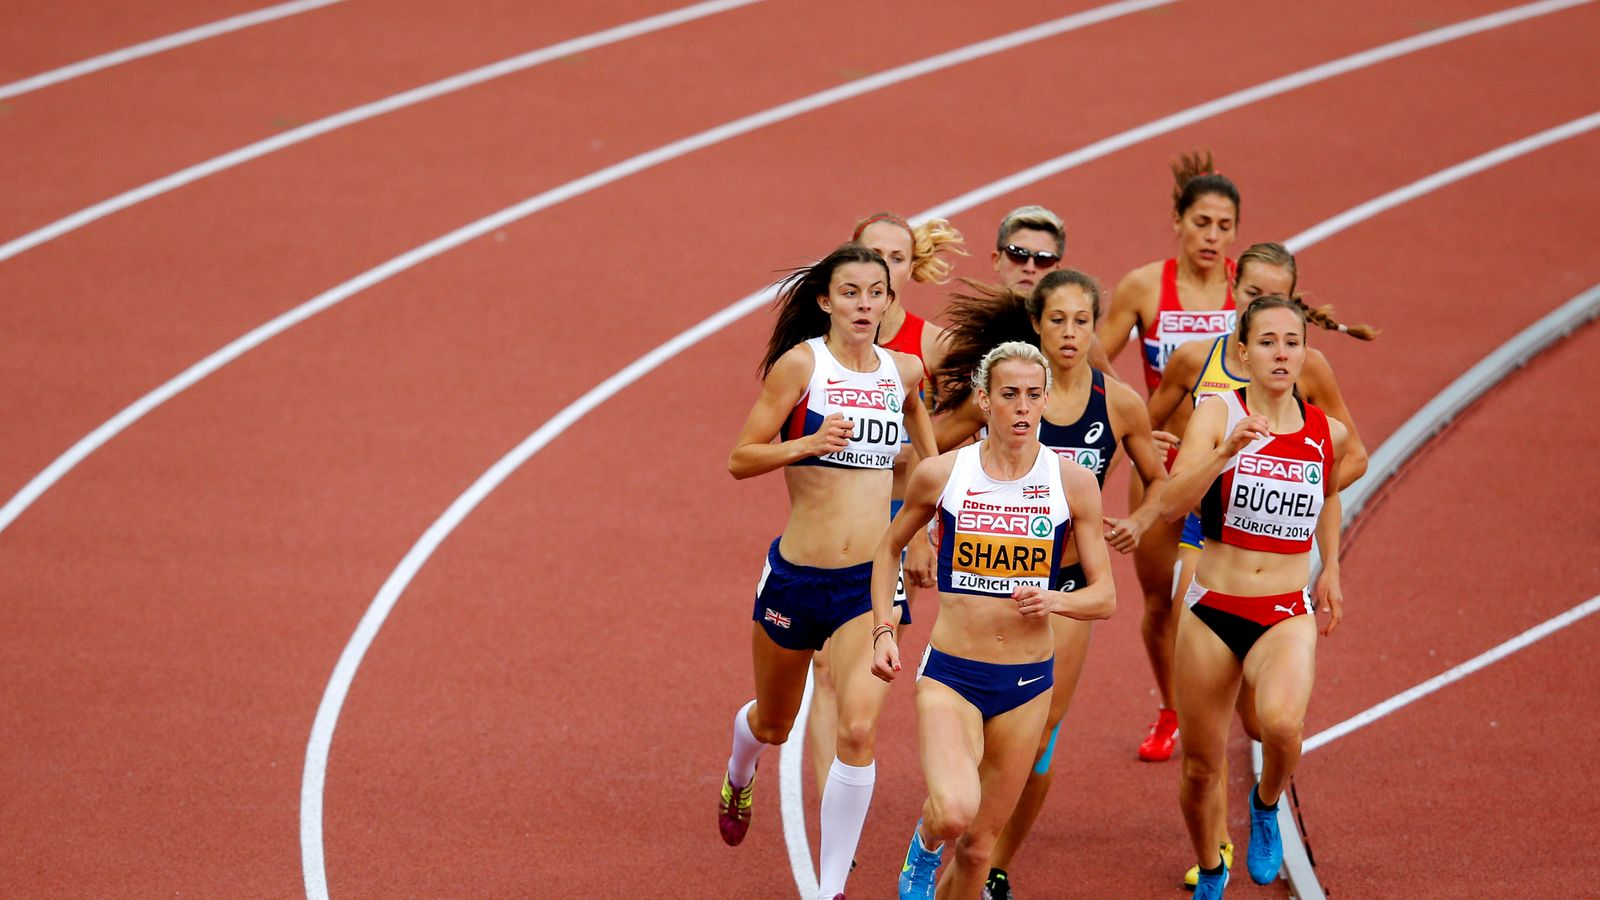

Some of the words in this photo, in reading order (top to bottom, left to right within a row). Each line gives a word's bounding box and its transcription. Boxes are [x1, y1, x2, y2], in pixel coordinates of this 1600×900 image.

[1163, 315, 1225, 331] SPAR
[826, 390, 885, 408] SPAR
[842, 415, 899, 446] UDD
[1239, 457, 1303, 480] SPAR
[1233, 482, 1316, 518] BÜCHEL
[959, 513, 1027, 532] SPAR
[1233, 516, 1283, 536] ZÜRICH
[1285, 526, 1310, 538] 2014
[957, 541, 1047, 572] SHARP
[959, 573, 1010, 591] ZÜRICH
